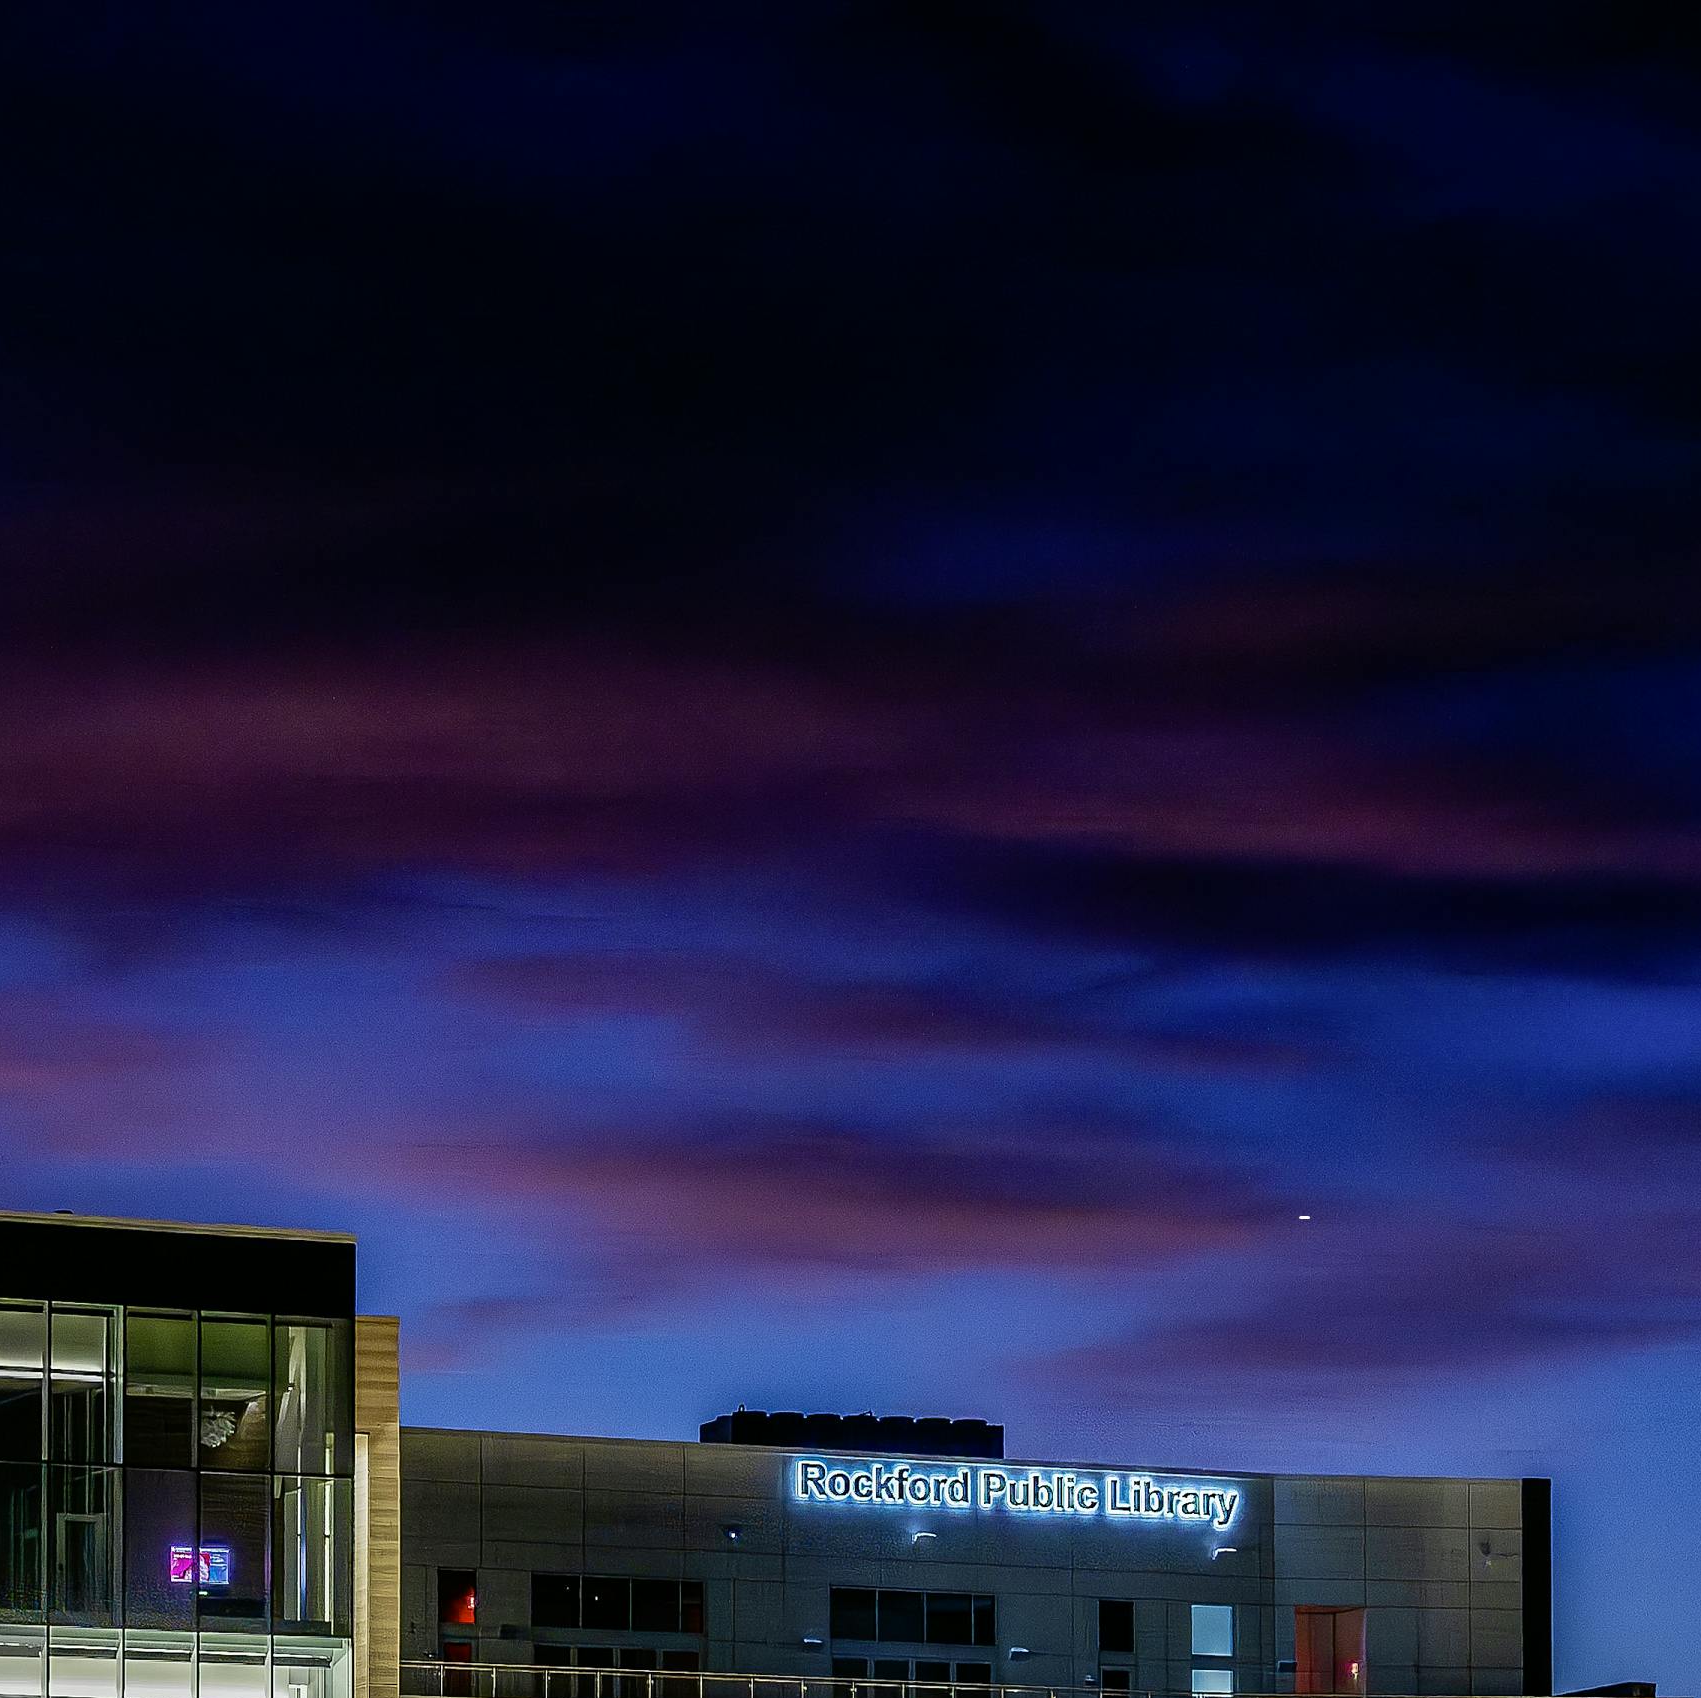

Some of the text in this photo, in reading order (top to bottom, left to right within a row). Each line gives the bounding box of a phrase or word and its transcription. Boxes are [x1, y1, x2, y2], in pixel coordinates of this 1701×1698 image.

[799, 1460, 1238, 1526] Rockford Public Library
